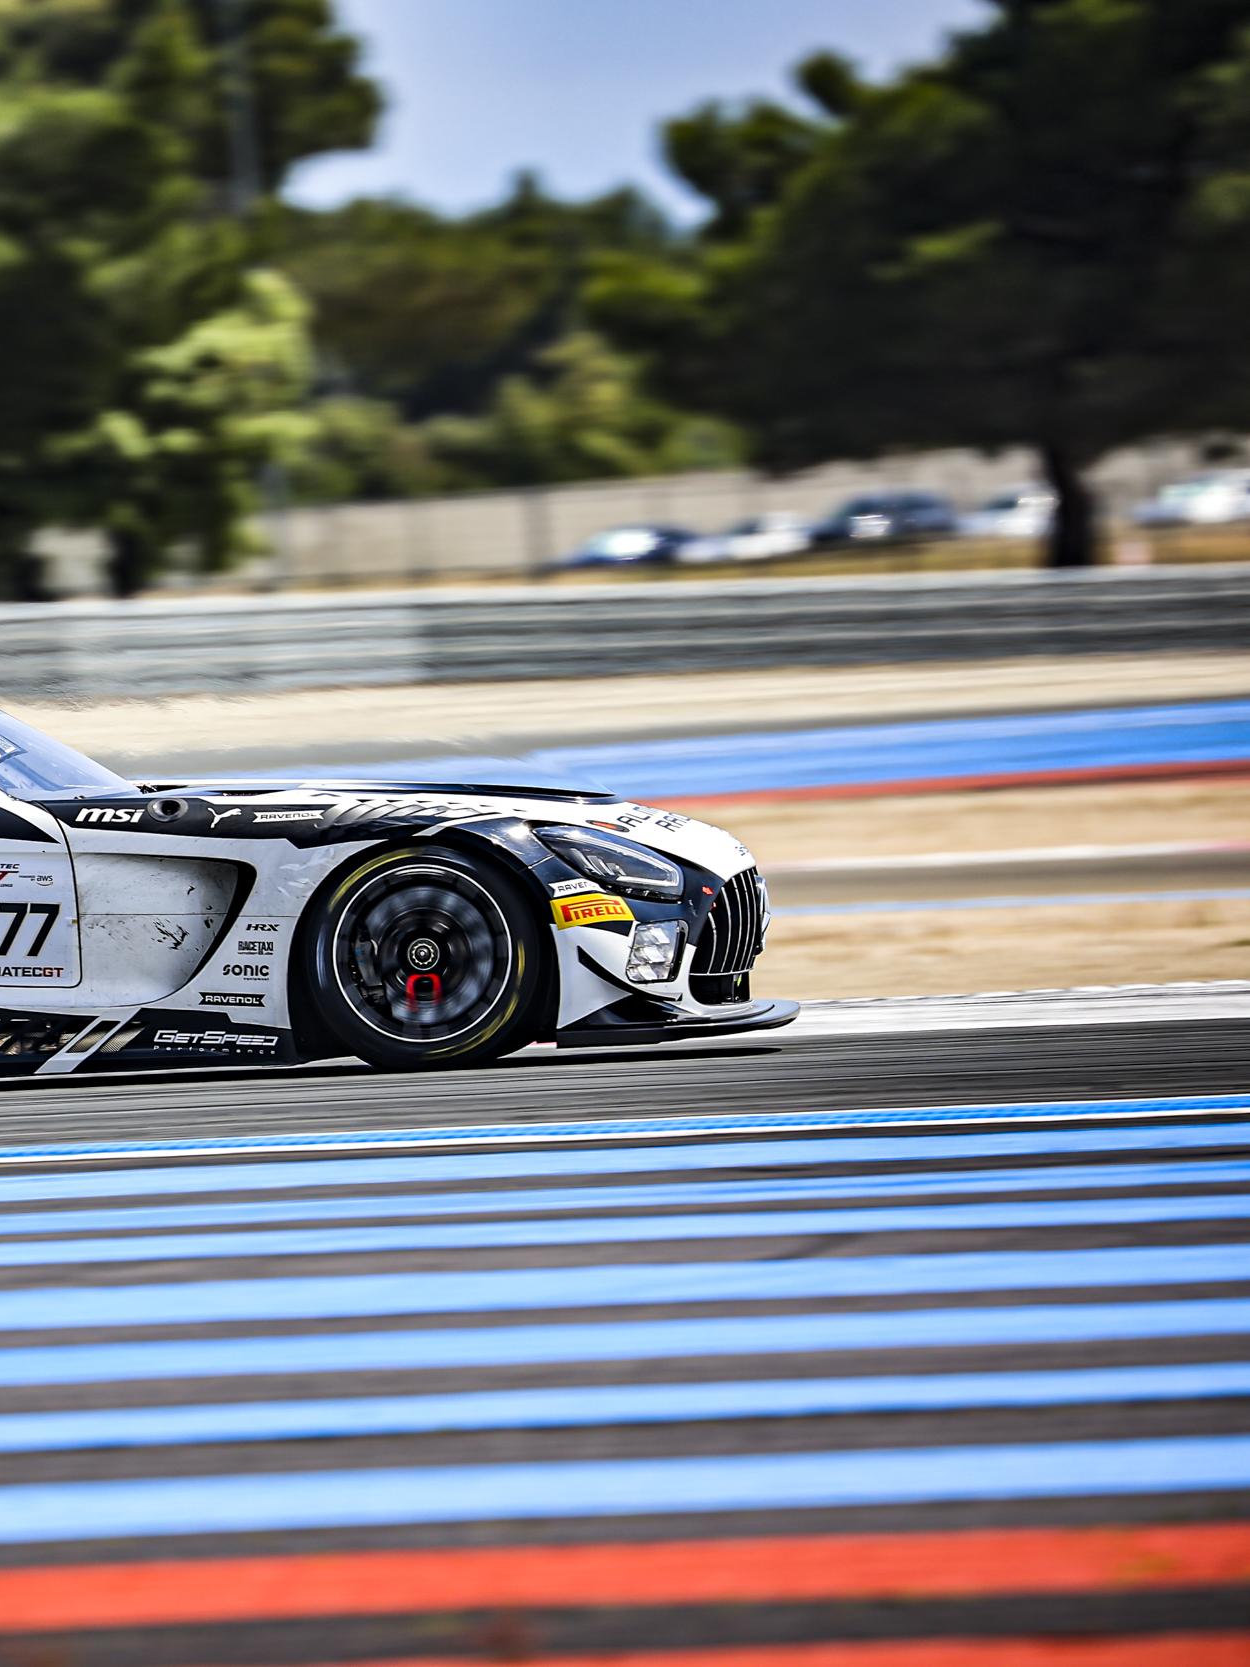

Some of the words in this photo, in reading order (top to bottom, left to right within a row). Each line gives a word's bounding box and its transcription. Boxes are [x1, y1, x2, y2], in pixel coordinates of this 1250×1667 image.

[75, 807, 145, 823] msi
[260, 812, 317, 820] RAVENOL
[560, 899, 626, 922] PIRELLI
[246, 923, 280, 932] HRX
[205, 994, 260, 1004] RAVENOL
[153, 1045, 276, 1055] Performance
